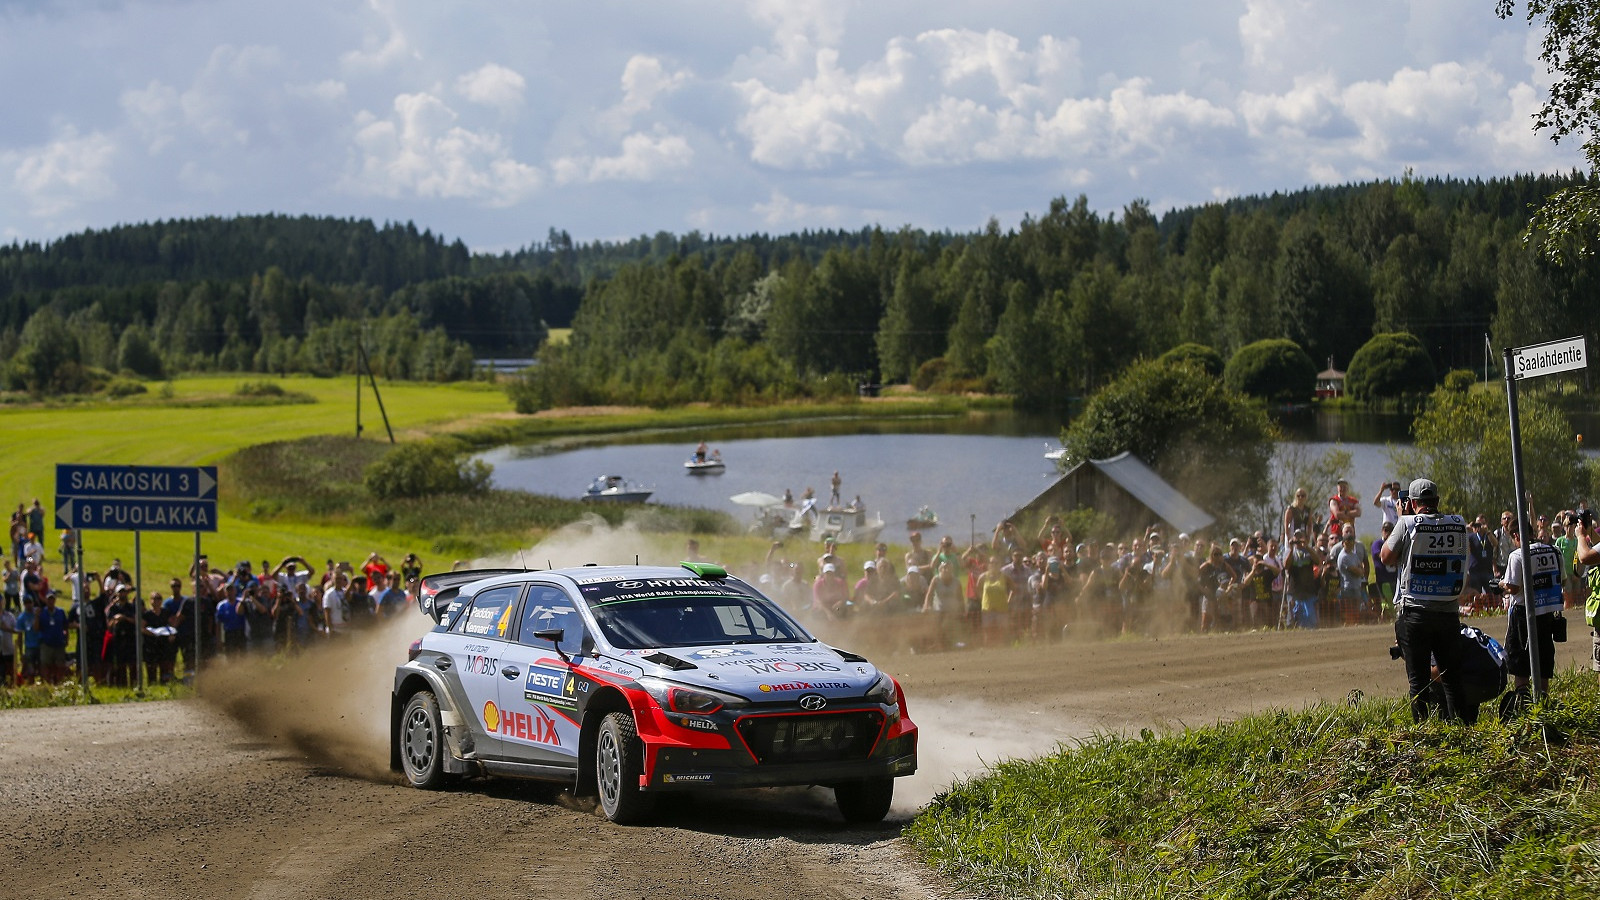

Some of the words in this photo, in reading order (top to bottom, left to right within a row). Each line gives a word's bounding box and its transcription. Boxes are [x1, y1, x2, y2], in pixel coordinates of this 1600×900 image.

[1519, 346, 1582, 371] Saalahdentie
[71, 471, 170, 491] SAAKOSKI
[179, 474, 190, 492] 3
[82, 505, 92, 522] 8
[102, 505, 208, 525] PUOLAKKA
[1429, 535, 1455, 549] 249
[1414, 559, 1443, 569] Lexar
[647, 577, 726, 588] HYUNDAI
[1411, 585, 1434, 593] 2016
[634, 591, 656, 599] World
[656, 589, 674, 597] Rally
[471, 606, 494, 619] Paddon
[497, 604, 512, 637] 4
[465, 621, 489, 635] Kennard
[464, 655, 498, 676] MOBIS
[718, 657, 788, 667] HYUNDAI
[747, 662, 841, 675] MOBIS
[528, 672, 561, 689] NESTE
[566, 676, 575, 695] 4
[772, 682, 814, 692] HELIX
[501, 709, 561, 746] HELIX
[689, 720, 718, 730] HELIX
[676, 773, 711, 781] MICHELIN
